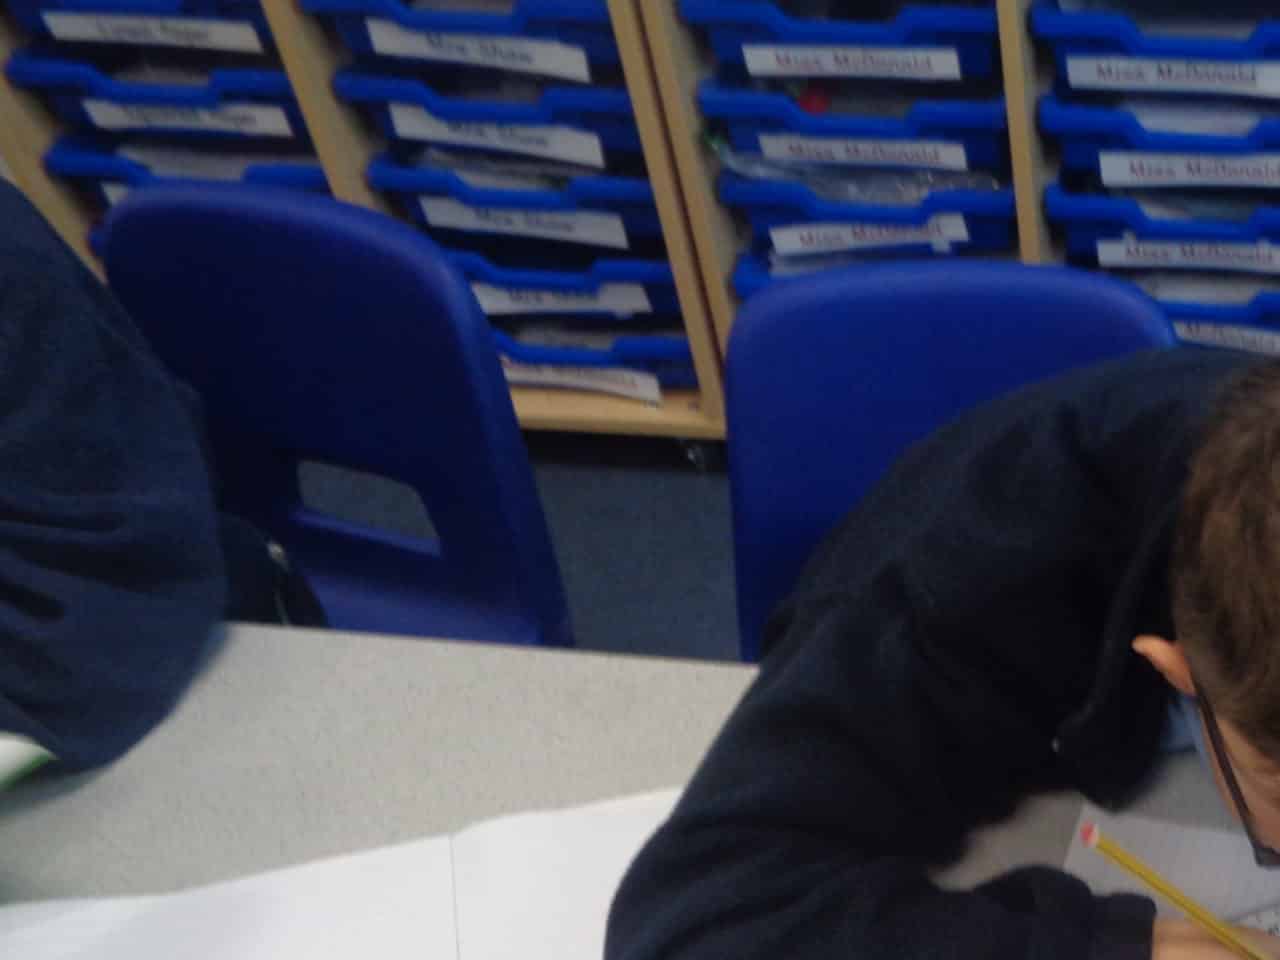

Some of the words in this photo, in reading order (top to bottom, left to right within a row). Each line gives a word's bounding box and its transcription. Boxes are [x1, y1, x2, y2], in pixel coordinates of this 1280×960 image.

[775, 51, 821, 70] Miss
[833, 50, 934, 73] McDonald
[1096, 63, 1145, 80] Miss
[1156, 64, 1258, 82] McDonald
[788, 143, 835, 161] Miss
[845, 143, 940, 163] McDonald
[1128, 160, 1176, 177] Miss
[1125, 245, 1169, 259] Miss
